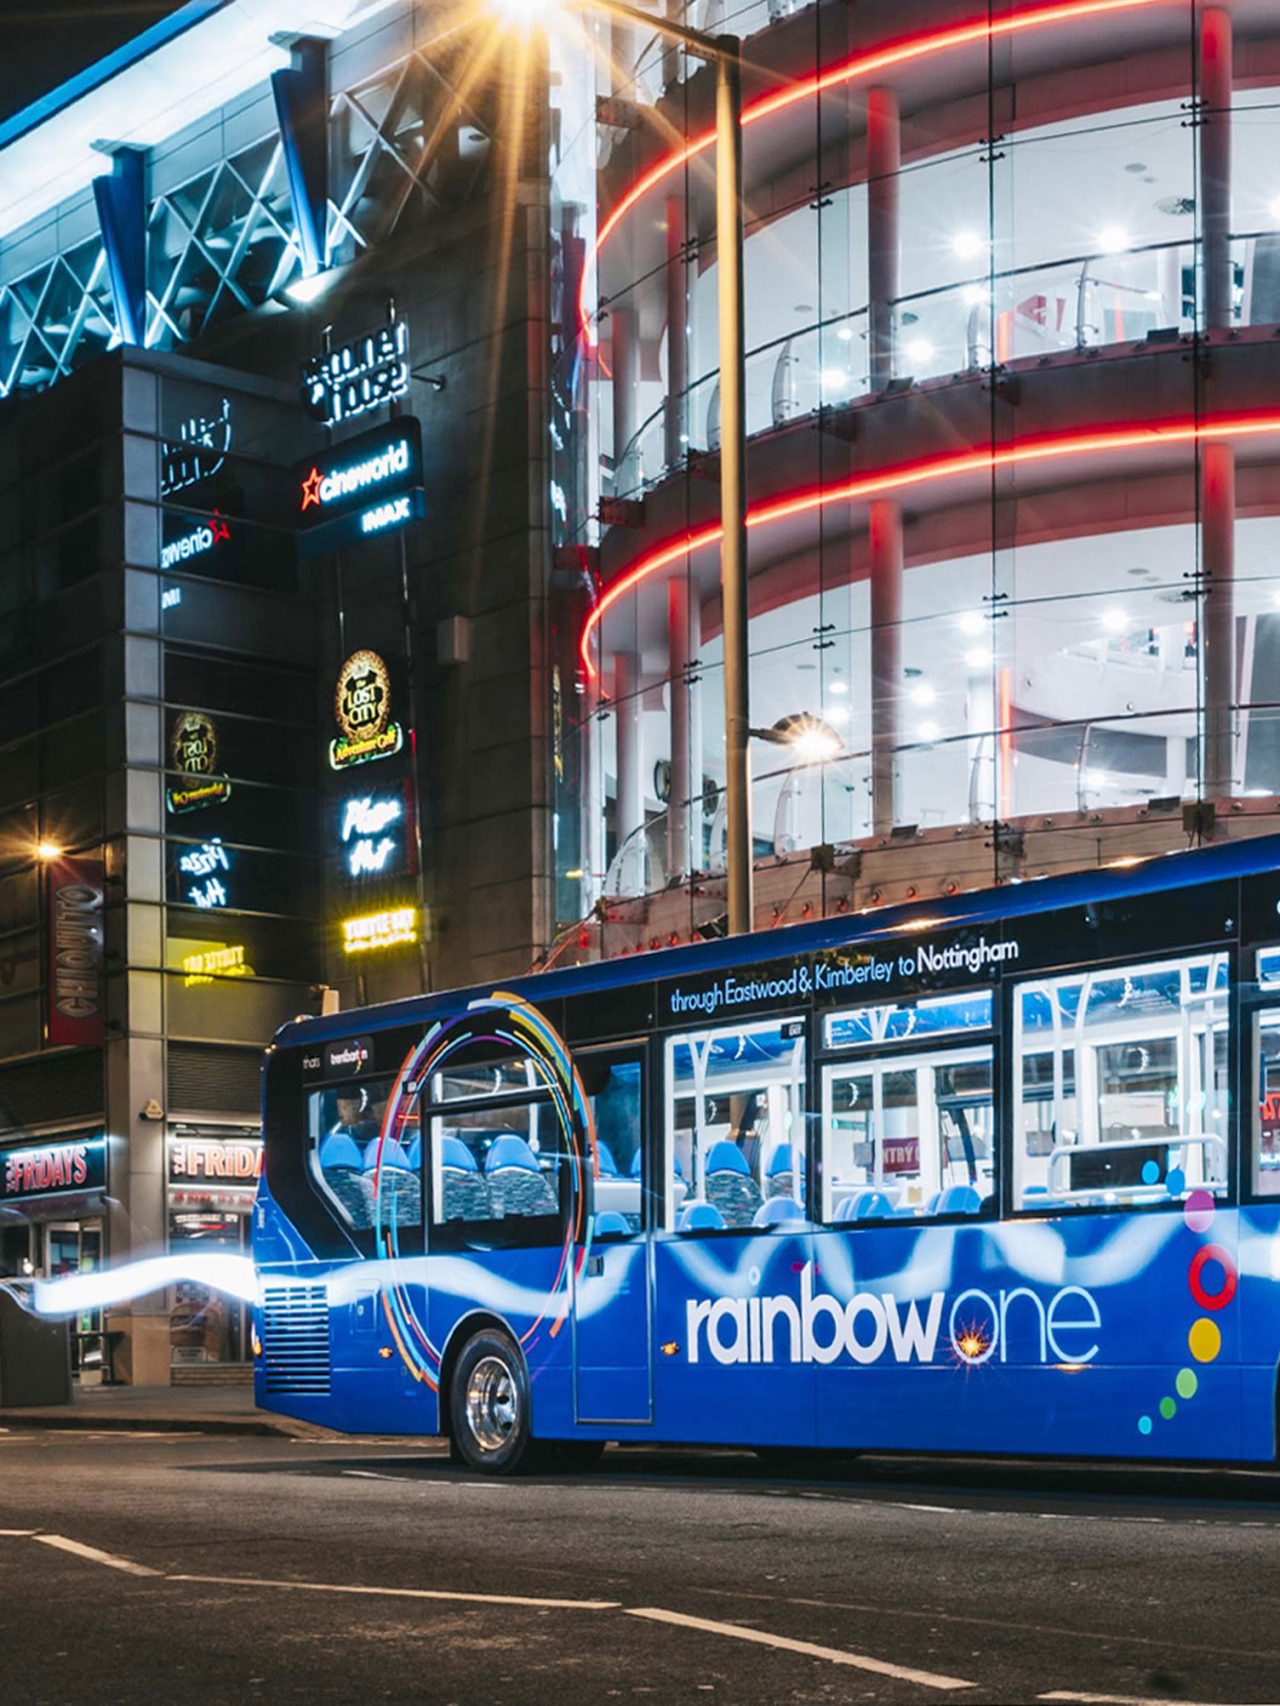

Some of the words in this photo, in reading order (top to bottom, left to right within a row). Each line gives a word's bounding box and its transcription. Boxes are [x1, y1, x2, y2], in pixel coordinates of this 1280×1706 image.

[319, 440, 409, 502] cineworld
[347, 684, 377, 709] LOST
[671, 982, 724, 1013] through
[725, 969, 797, 1005] Eastwood
[798, 966, 813, 992] &
[815, 957, 894, 990] Kimberley
[898, 956, 915, 976] to
[917, 937, 1019, 974] Nottingham
